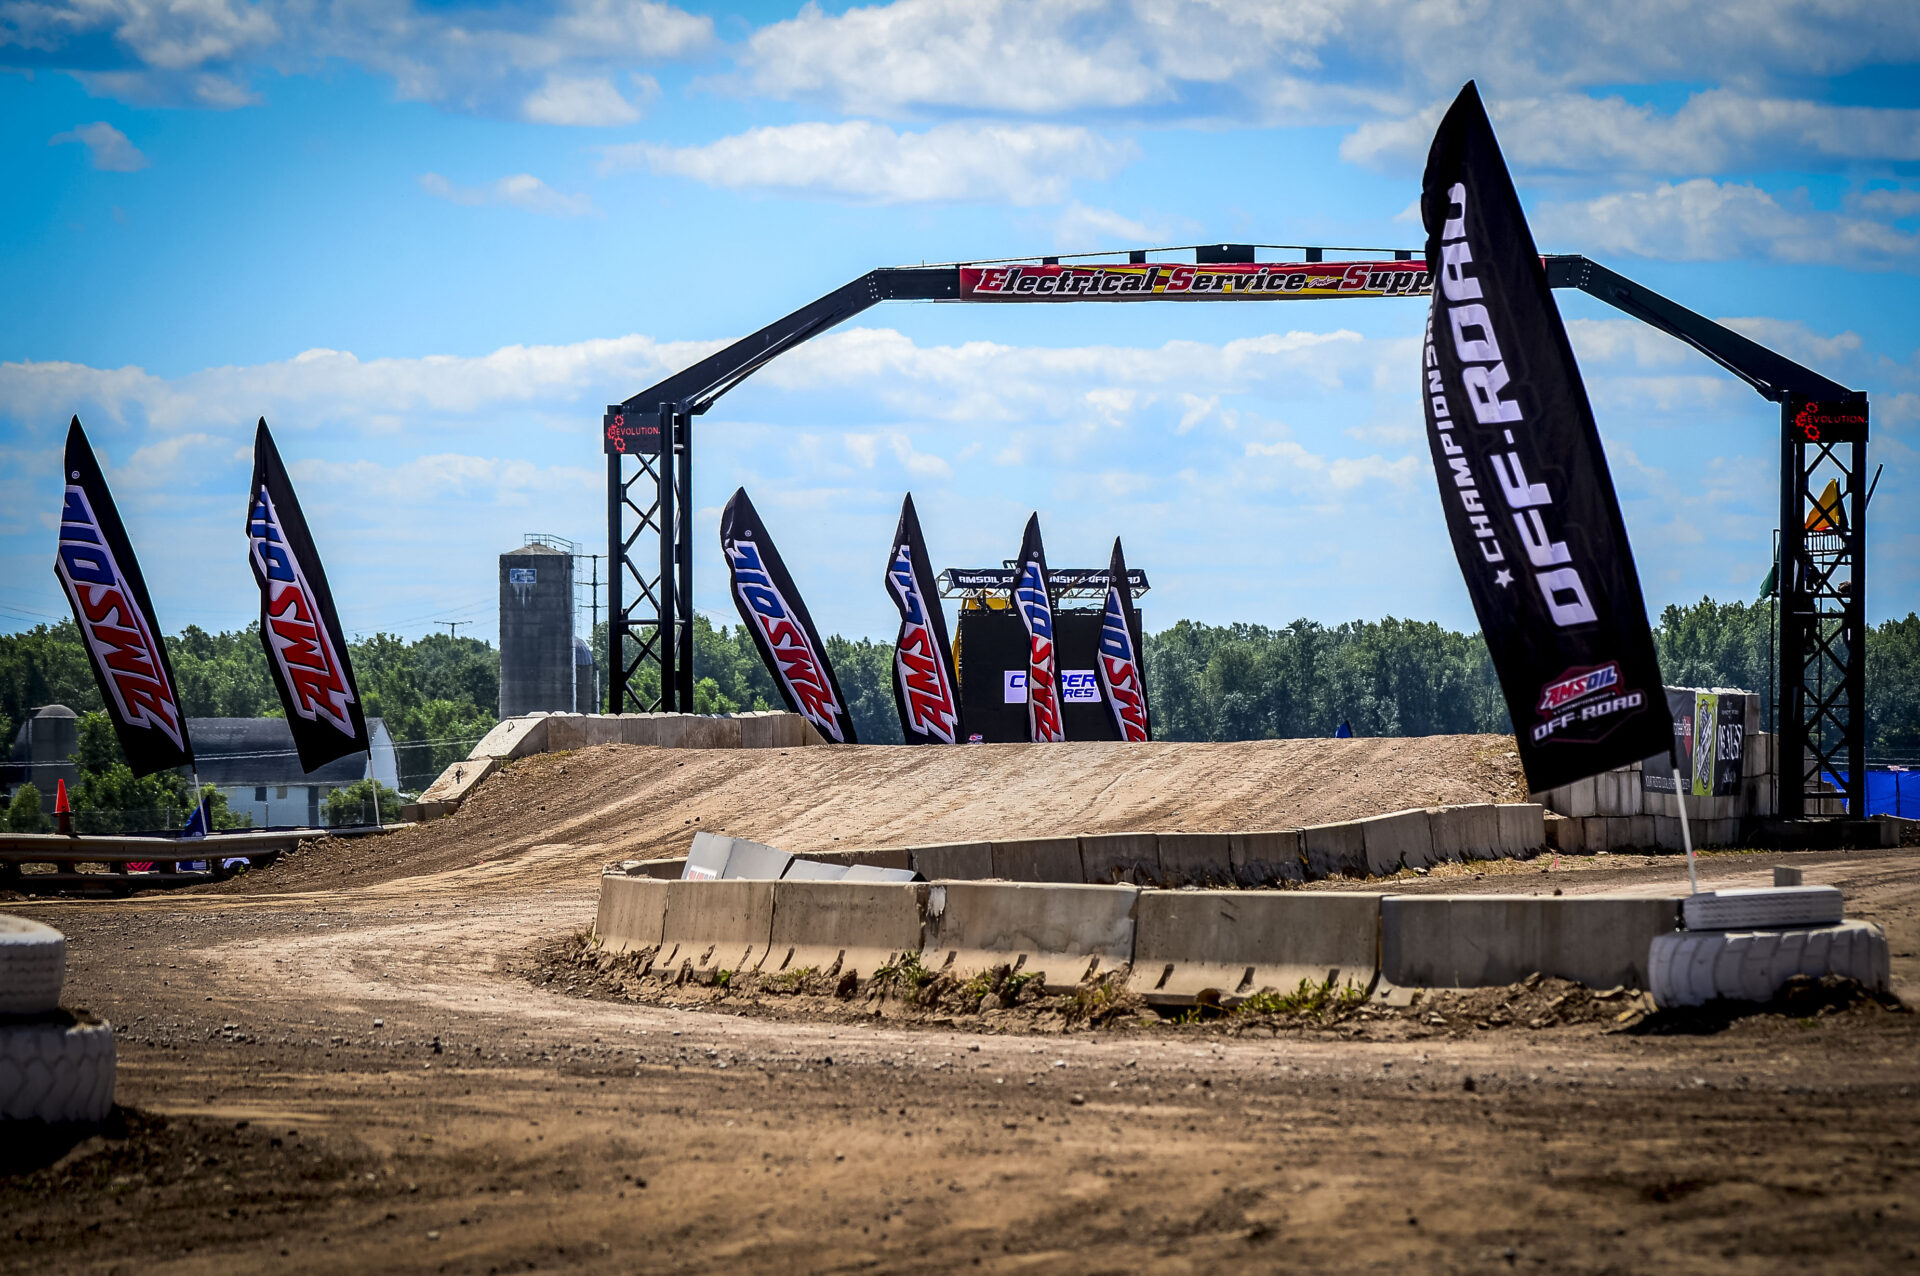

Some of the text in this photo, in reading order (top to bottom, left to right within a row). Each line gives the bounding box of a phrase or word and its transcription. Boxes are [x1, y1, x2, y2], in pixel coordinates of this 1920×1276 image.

[973, 267, 1162, 296] Electrical
[1165, 266, 1308, 294] Service
[1338, 264, 1433, 296] Supp
[1442, 182, 1598, 627] OFF-ROAD
[1800, 415, 1865, 424] REVOLUTION
[611, 426, 659, 436] REVOLUTION
[1425, 303, 1505, 563] CHAMPIONSHI
[959, 576, 999, 584] AMSOIL
[57, 485, 185, 752] AMSOIL
[250, 484, 356, 739] AMSOIL
[726, 540, 845, 743] AMSOIL
[889, 545, 958, 744] AMSOIL
[1010, 674, 1096, 688] CER
[1063, 688, 1094, 698] RES
[1541, 665, 1618, 710] AMSOIL
[1534, 693, 1642, 741] OFF-ROAD
